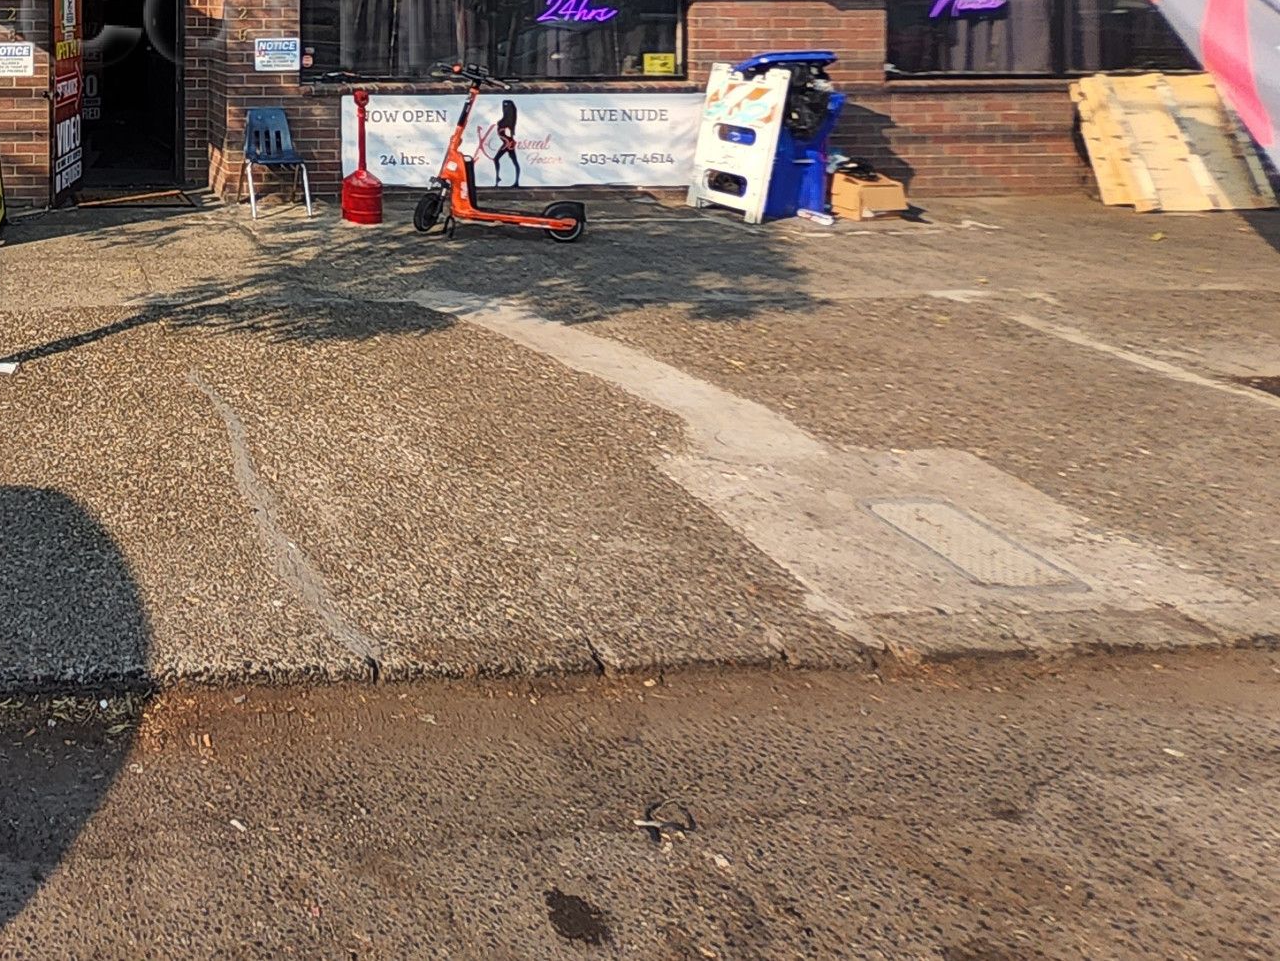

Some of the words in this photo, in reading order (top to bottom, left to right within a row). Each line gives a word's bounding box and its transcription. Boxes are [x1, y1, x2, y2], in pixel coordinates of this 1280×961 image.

[258, 40, 297, 51] NOTICE
[402, 110, 448, 123] OPEN
[580, 109, 618, 122] LIVE
[621, 109, 669, 122] NUDE
[56, 114, 82, 157] VIDEO
[380, 154, 398, 166] 24
[400, 152, 431, 166] hrs.
[579, 153, 675, 166] 503-477-4614
